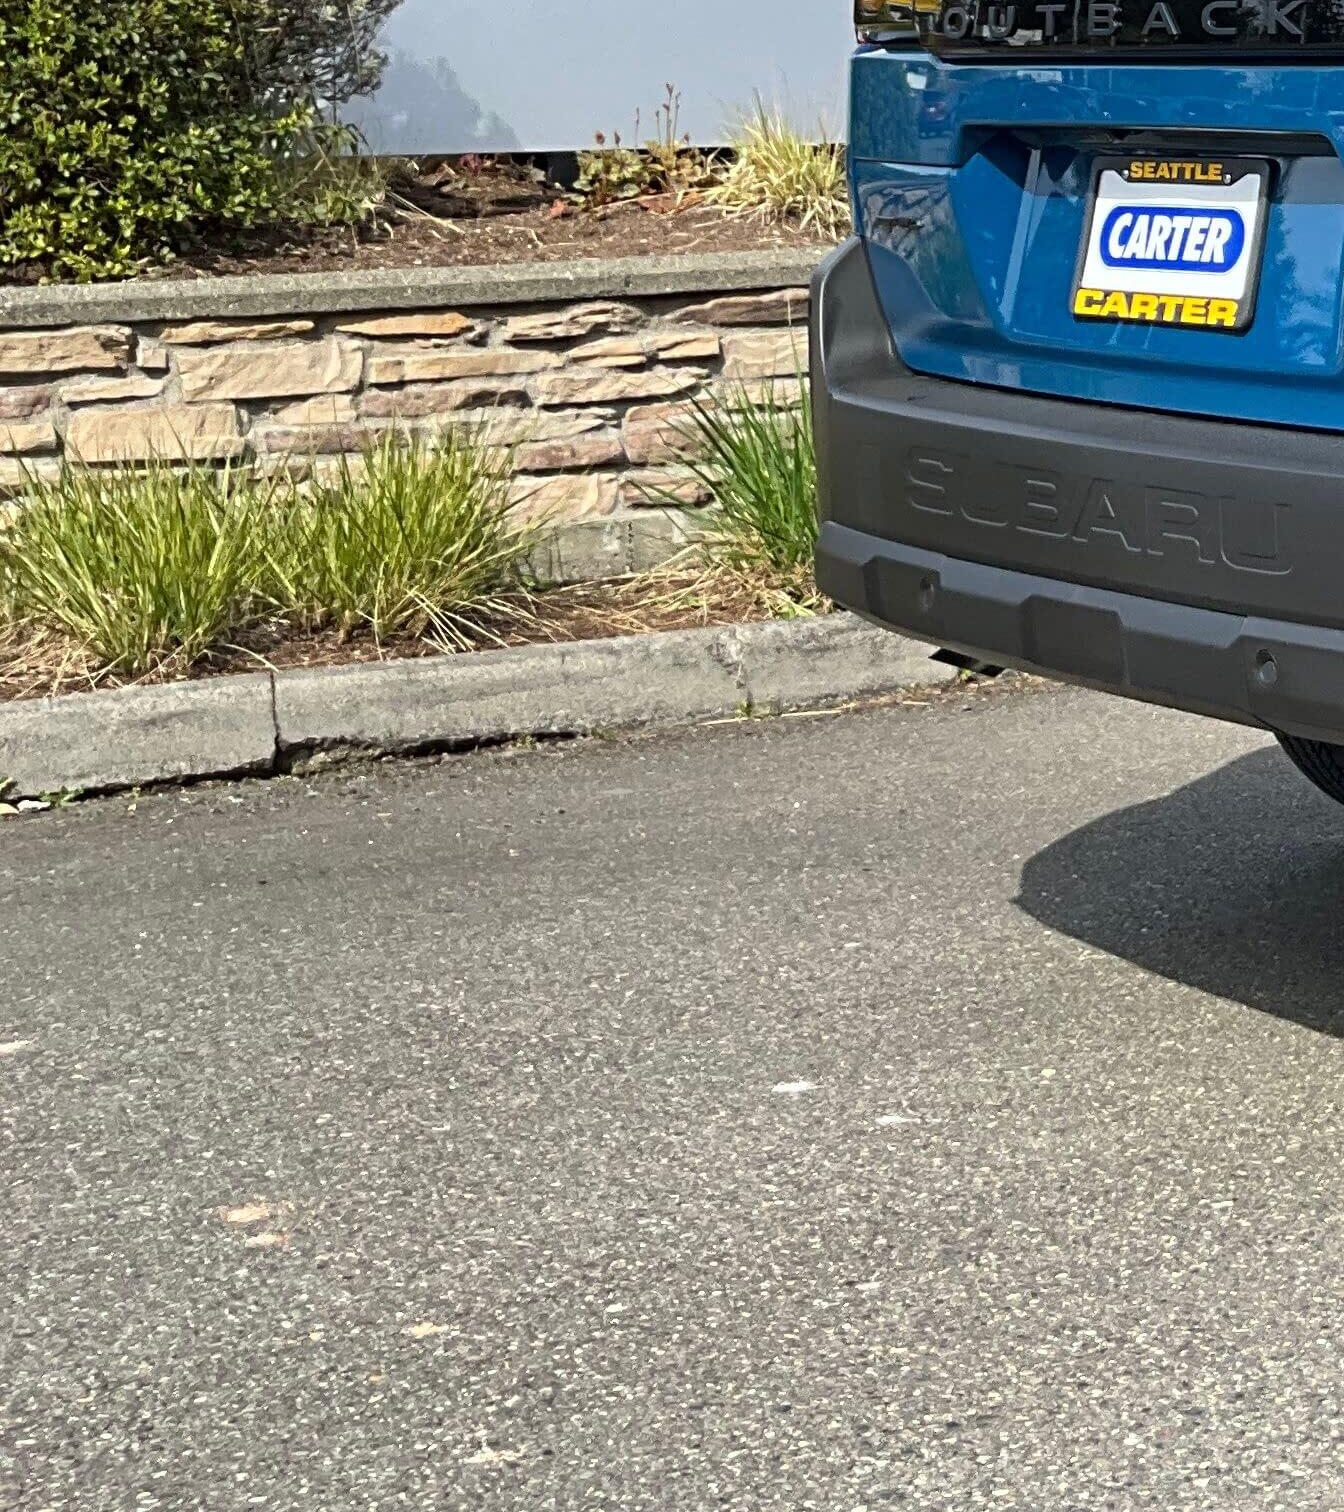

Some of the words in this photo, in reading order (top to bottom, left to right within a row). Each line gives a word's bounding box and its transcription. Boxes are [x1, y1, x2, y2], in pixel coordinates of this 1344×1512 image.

[943, 0, 1304, 39] OUTBACK
[1130, 161, 1223, 181] SEATTLE
[1108, 212, 1233, 264] CARTER
[1073, 288, 1239, 327] CARTER
[907, 445, 1294, 575] SUBARU
